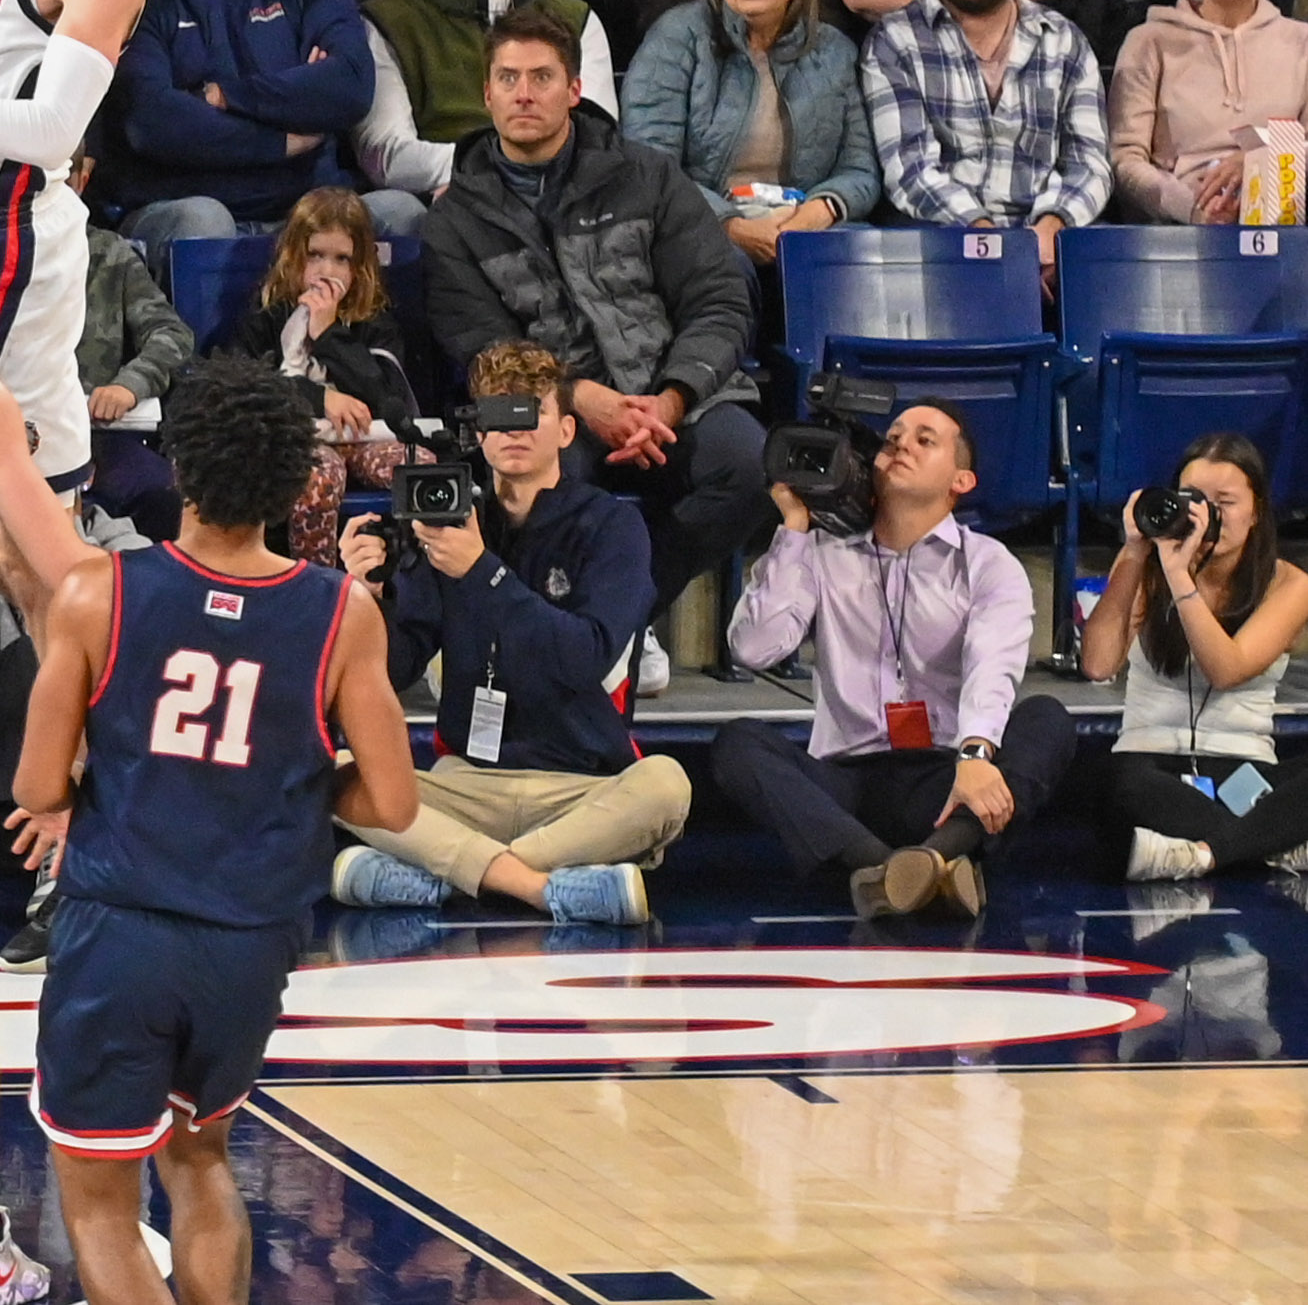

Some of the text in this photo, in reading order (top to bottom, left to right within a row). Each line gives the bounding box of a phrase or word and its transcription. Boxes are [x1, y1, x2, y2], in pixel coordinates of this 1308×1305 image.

[976, 236, 990, 258] 5
[1252, 231, 1266, 255] 6
[149, 647, 263, 768] 21
